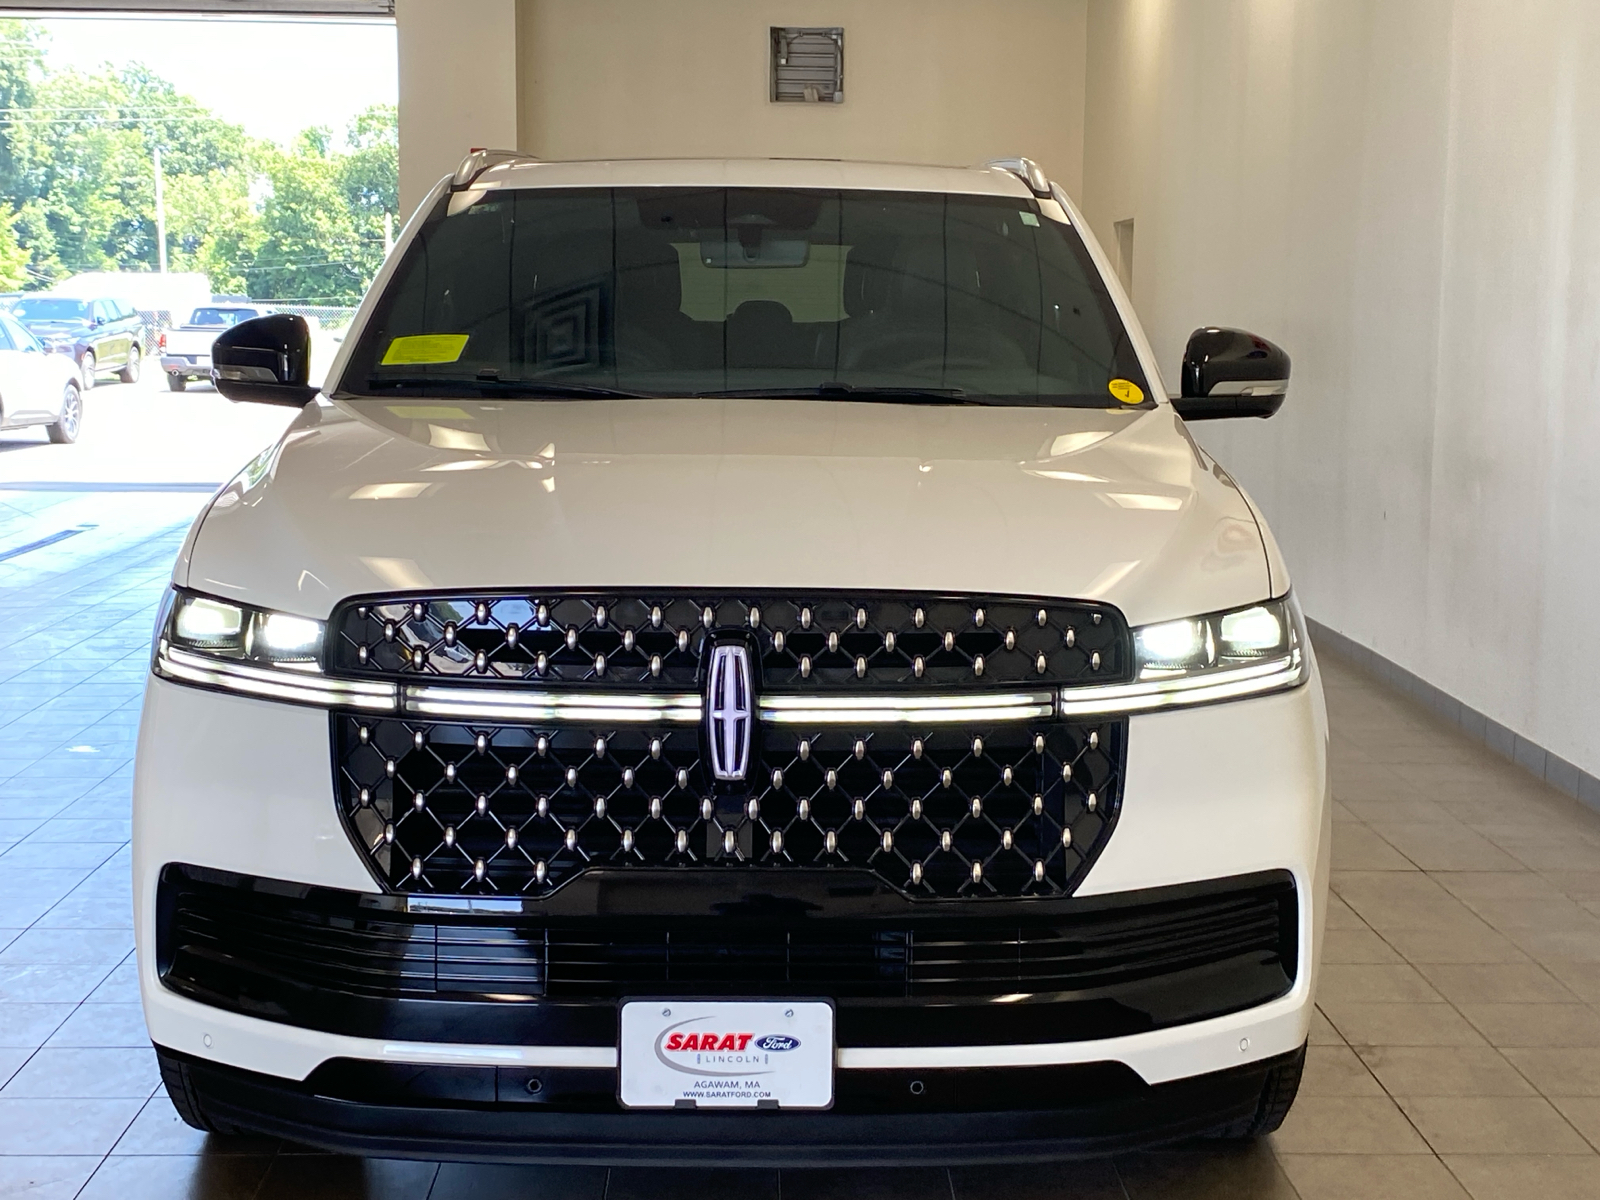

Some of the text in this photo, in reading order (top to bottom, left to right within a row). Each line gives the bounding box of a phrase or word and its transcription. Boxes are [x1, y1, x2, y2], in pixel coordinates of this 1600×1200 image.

[665, 1033, 793, 1051] SARAT Ford
[706, 1055, 760, 1063] LINCOLN
[693, 1081, 761, 1090] AGAWAM, MA
